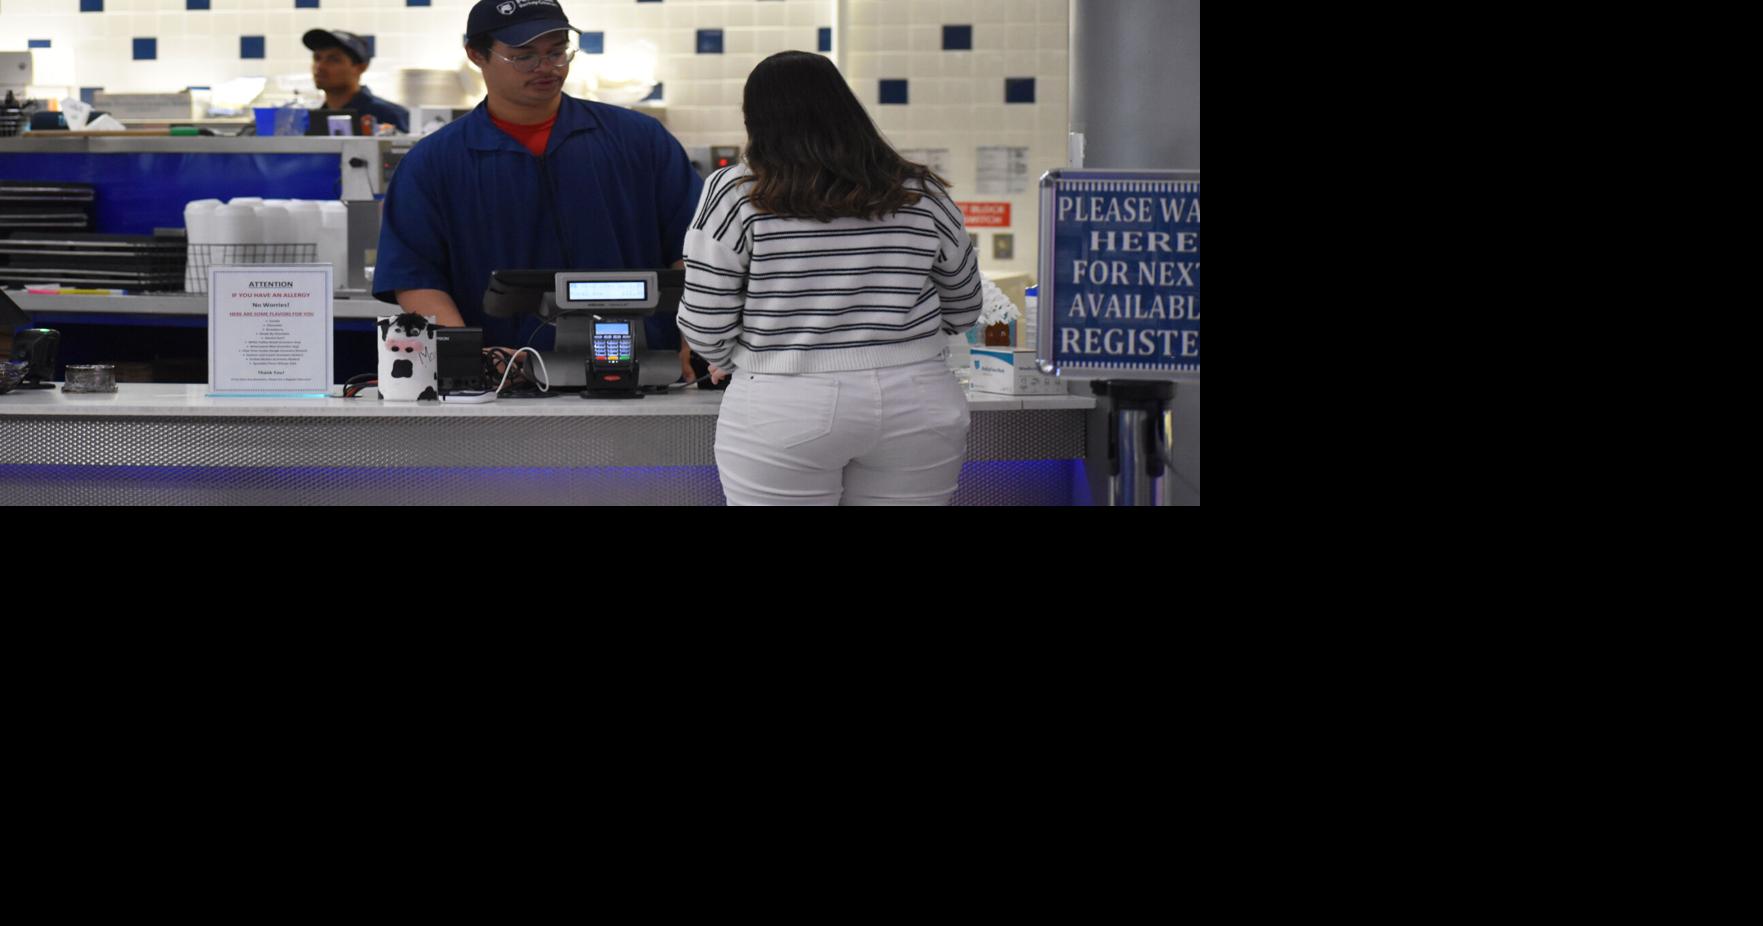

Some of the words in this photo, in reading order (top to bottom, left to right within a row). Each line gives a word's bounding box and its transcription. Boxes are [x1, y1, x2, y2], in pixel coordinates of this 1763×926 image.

[1058, 196, 1152, 223] PLEASE
[1090, 230, 1198, 252] HERE
[248, 281, 293, 289] ATTENTION
[1072, 260, 1129, 285] FOR
[1061, 327, 1199, 357] REGISTE
